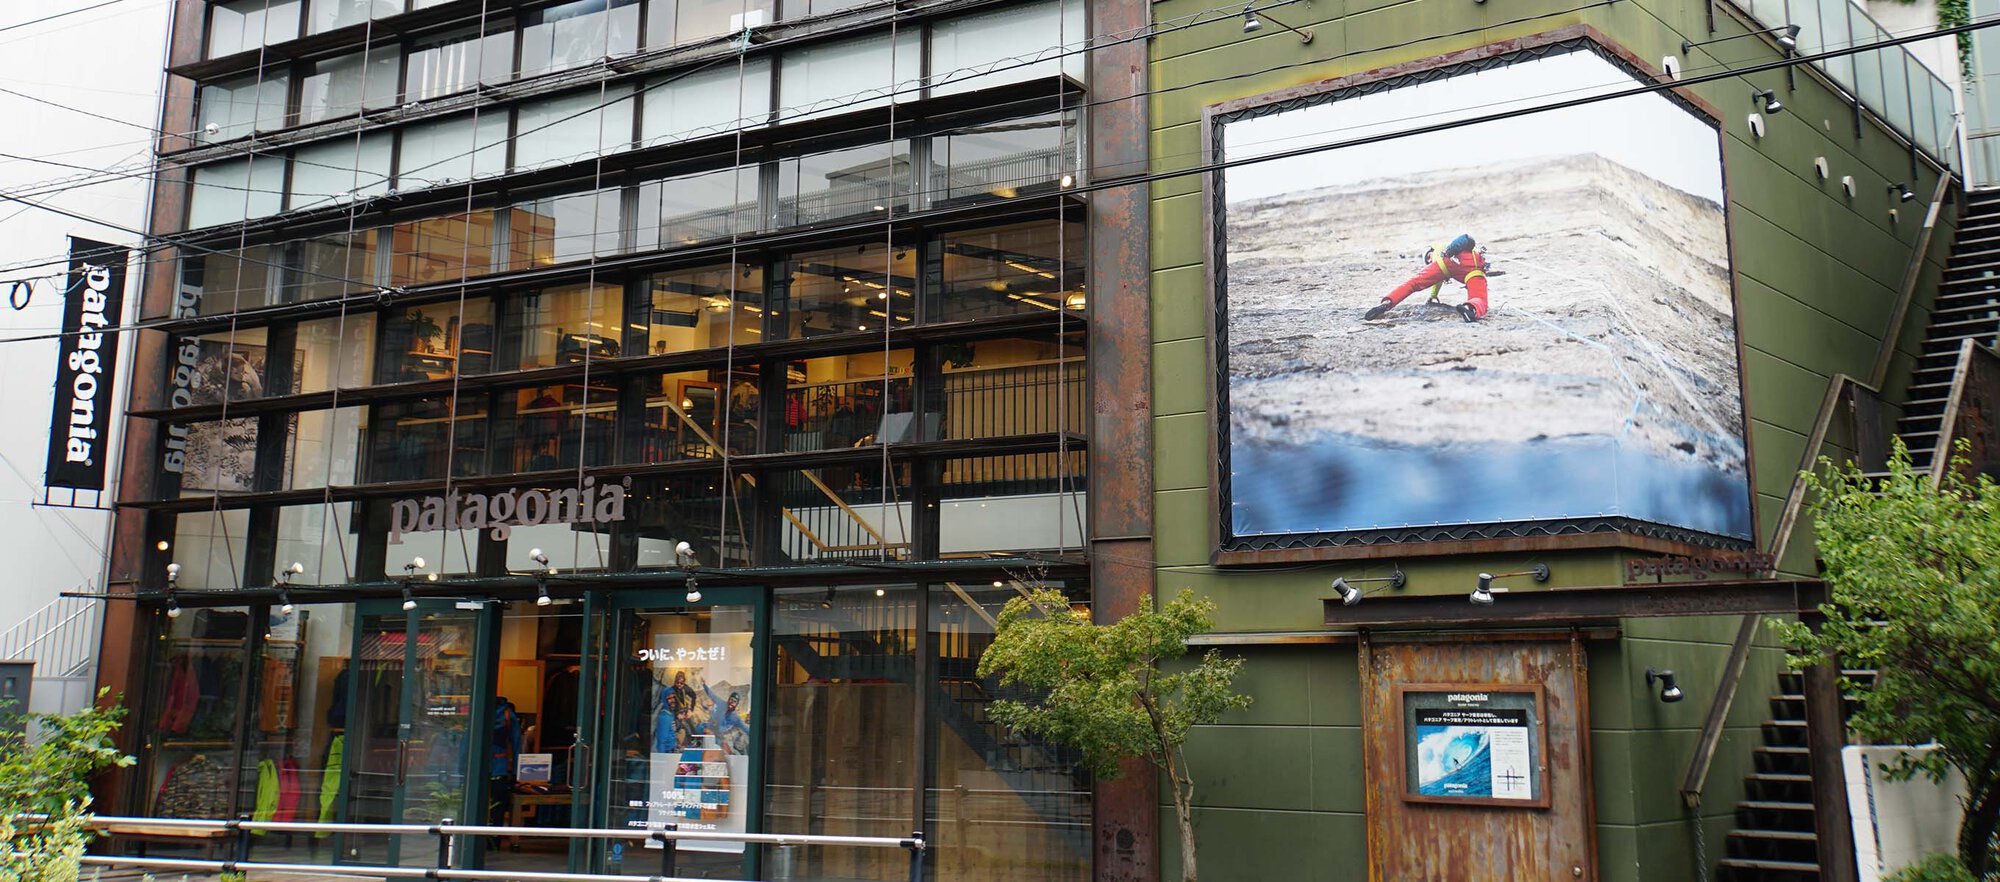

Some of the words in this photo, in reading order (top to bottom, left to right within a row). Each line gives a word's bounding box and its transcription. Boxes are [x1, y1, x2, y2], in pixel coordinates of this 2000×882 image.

[66, 262, 110, 464] patagonia
[389, 476, 632, 544] patagonia
[1626, 552, 1776, 581] patagonia
[1447, 693, 1488, 702] patagonia
